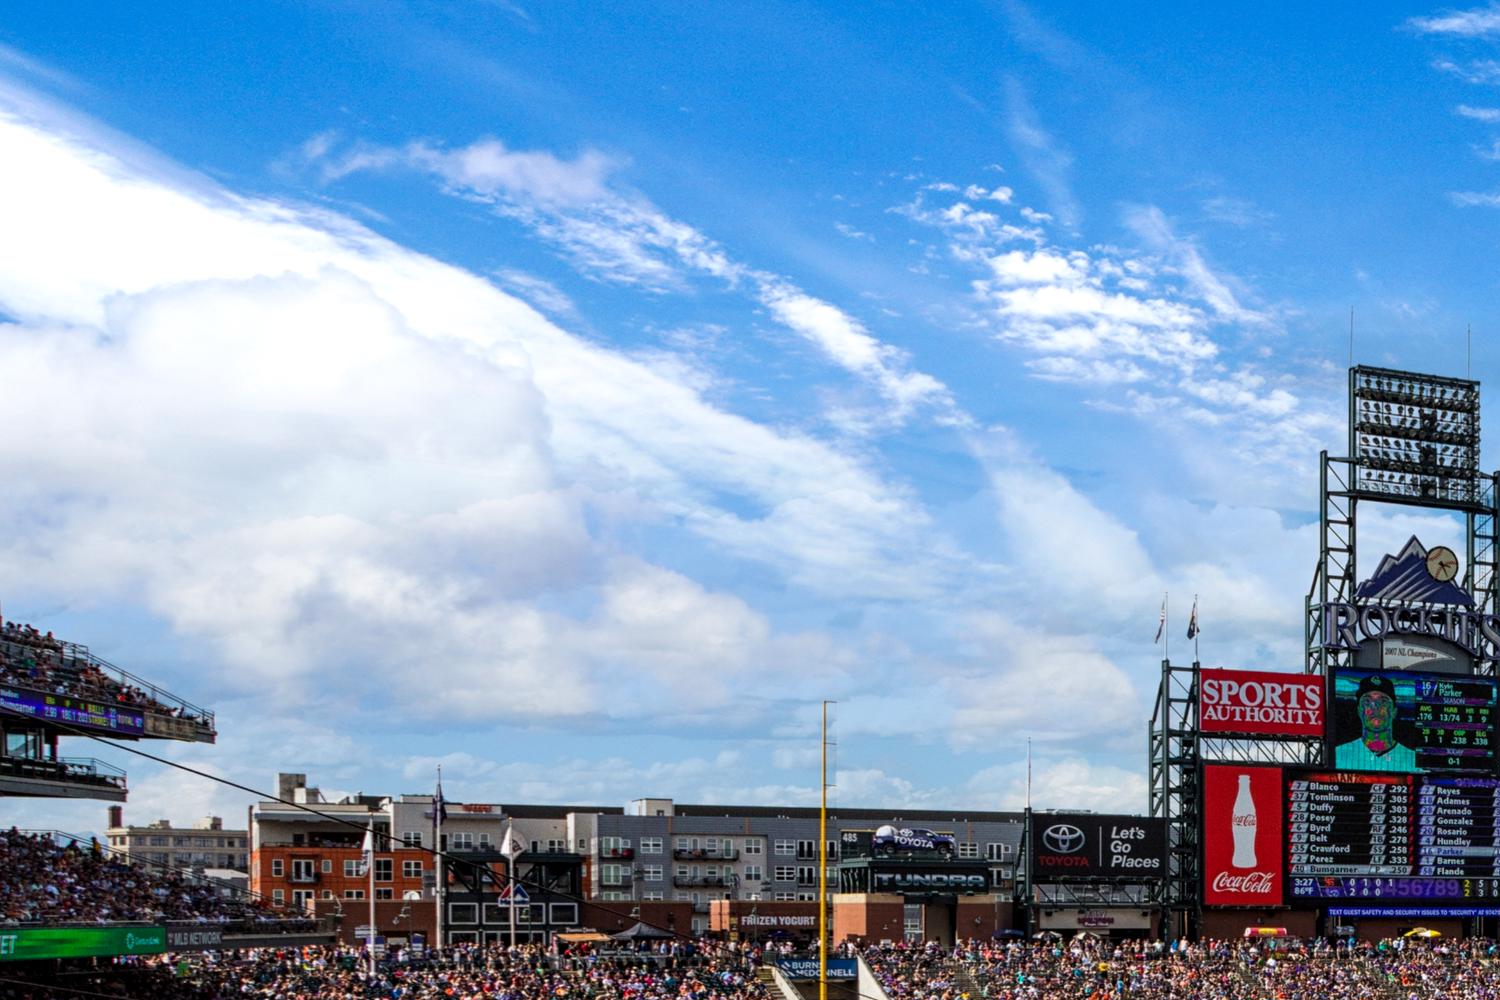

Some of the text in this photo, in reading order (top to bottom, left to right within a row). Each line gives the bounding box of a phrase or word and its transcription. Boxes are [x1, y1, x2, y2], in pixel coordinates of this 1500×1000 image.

[1422, 682, 1431, 690] 16
[1202, 679, 1320, 709] SPORTS
[1203, 705, 1320, 725] AUTHORITY
[1451, 737, 1467, 745] .238
[1309, 783, 1339, 791] Blanco
[1437, 787, 1461, 796] Reyes
[1309, 793, 1355, 801] Tomlinson
[1437, 797, 1470, 805] Adames
[1309, 804, 1334, 813] Duffy
[1437, 807, 1472, 815] Arenado
[1309, 814, 1335, 823] Posey
[1437, 817, 1474, 825] Gonzalez
[1111, 826, 1145, 839] Let's
[1309, 824, 1331, 834] Byrd
[843, 833, 858, 842] 485
[894, 835, 934, 849] TOYOTA
[1309, 834, 1328, 842] Belt
[1110, 841, 1131, 853] Go
[1437, 838, 1471, 847] Hundley
[1437, 848, 1464, 856] Parker
[1039, 856, 1089, 866] TOYOTA
[1111, 855, 1160, 868] Places
[1309, 855, 1334, 863] Perez
[1437, 857, 1465, 865] Barnes
[1309, 865, 1358, 874] Bumgarner
[1437, 867, 1465, 875] Flande
[877, 873, 985, 887] TUNDRA
[1212, 871, 1276, 893] Coca-Cola
[779, 916, 815, 926] YOGURT
[174, 932, 222, 946] MLB NETWORK
